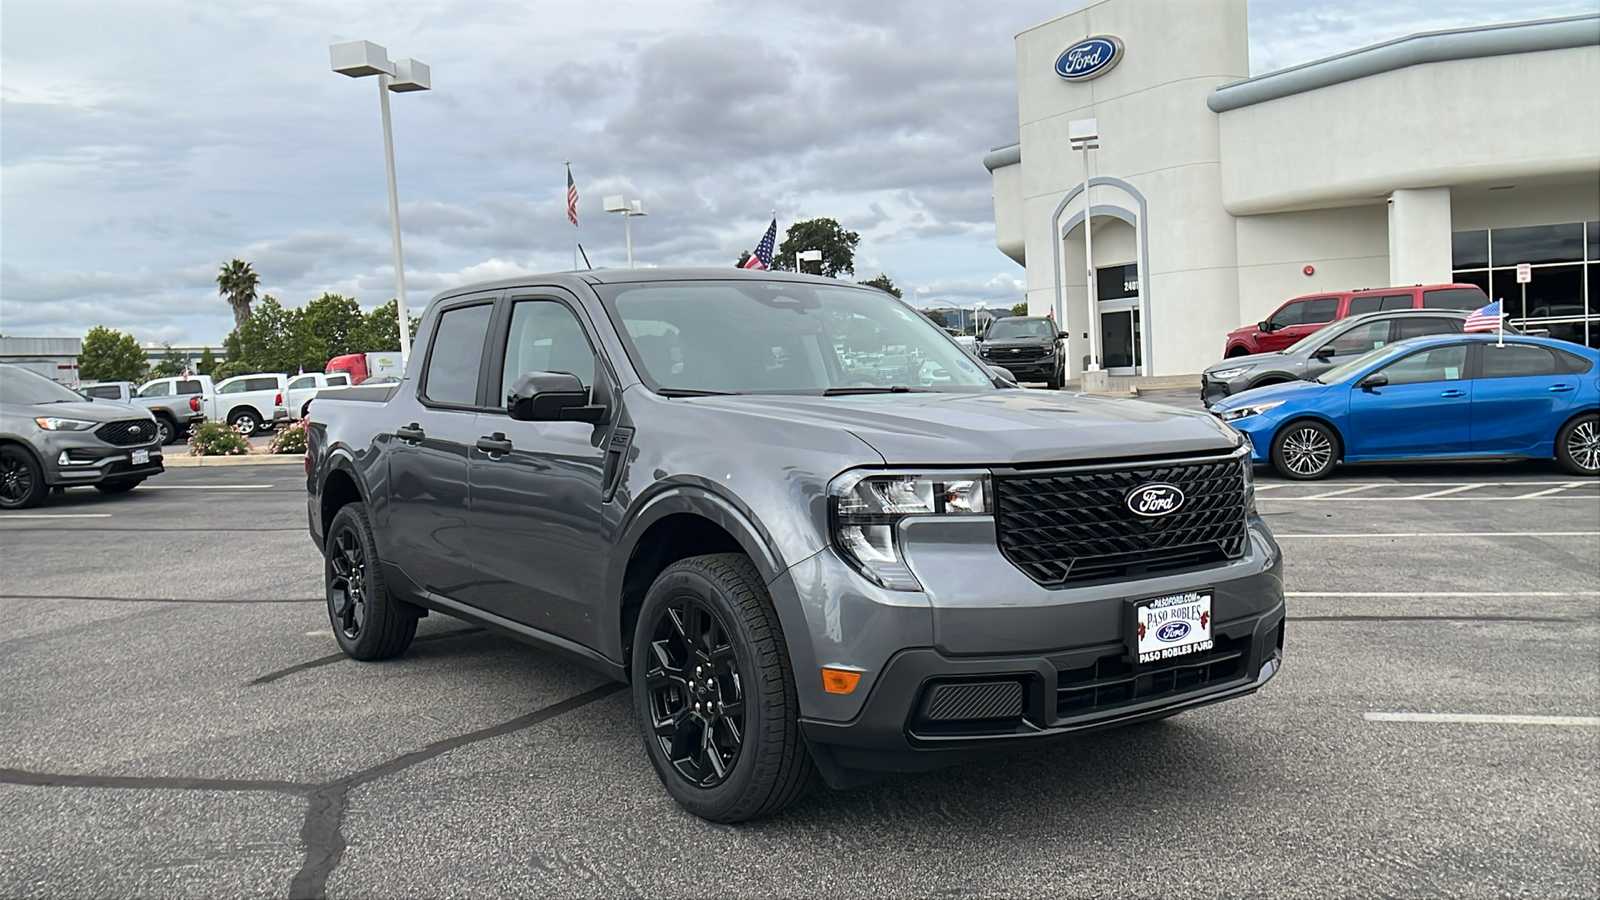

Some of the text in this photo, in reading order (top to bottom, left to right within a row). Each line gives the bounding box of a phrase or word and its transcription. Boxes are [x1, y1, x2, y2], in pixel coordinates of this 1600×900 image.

[1065, 45, 1102, 73] Ford
[1139, 489, 1175, 512] Ford
[1147, 605, 1201, 630] PASO ROBLES
[1163, 624, 1186, 639] Ford
[1139, 651, 1161, 663] PASO
[1162, 645, 1192, 658] ROBLES
